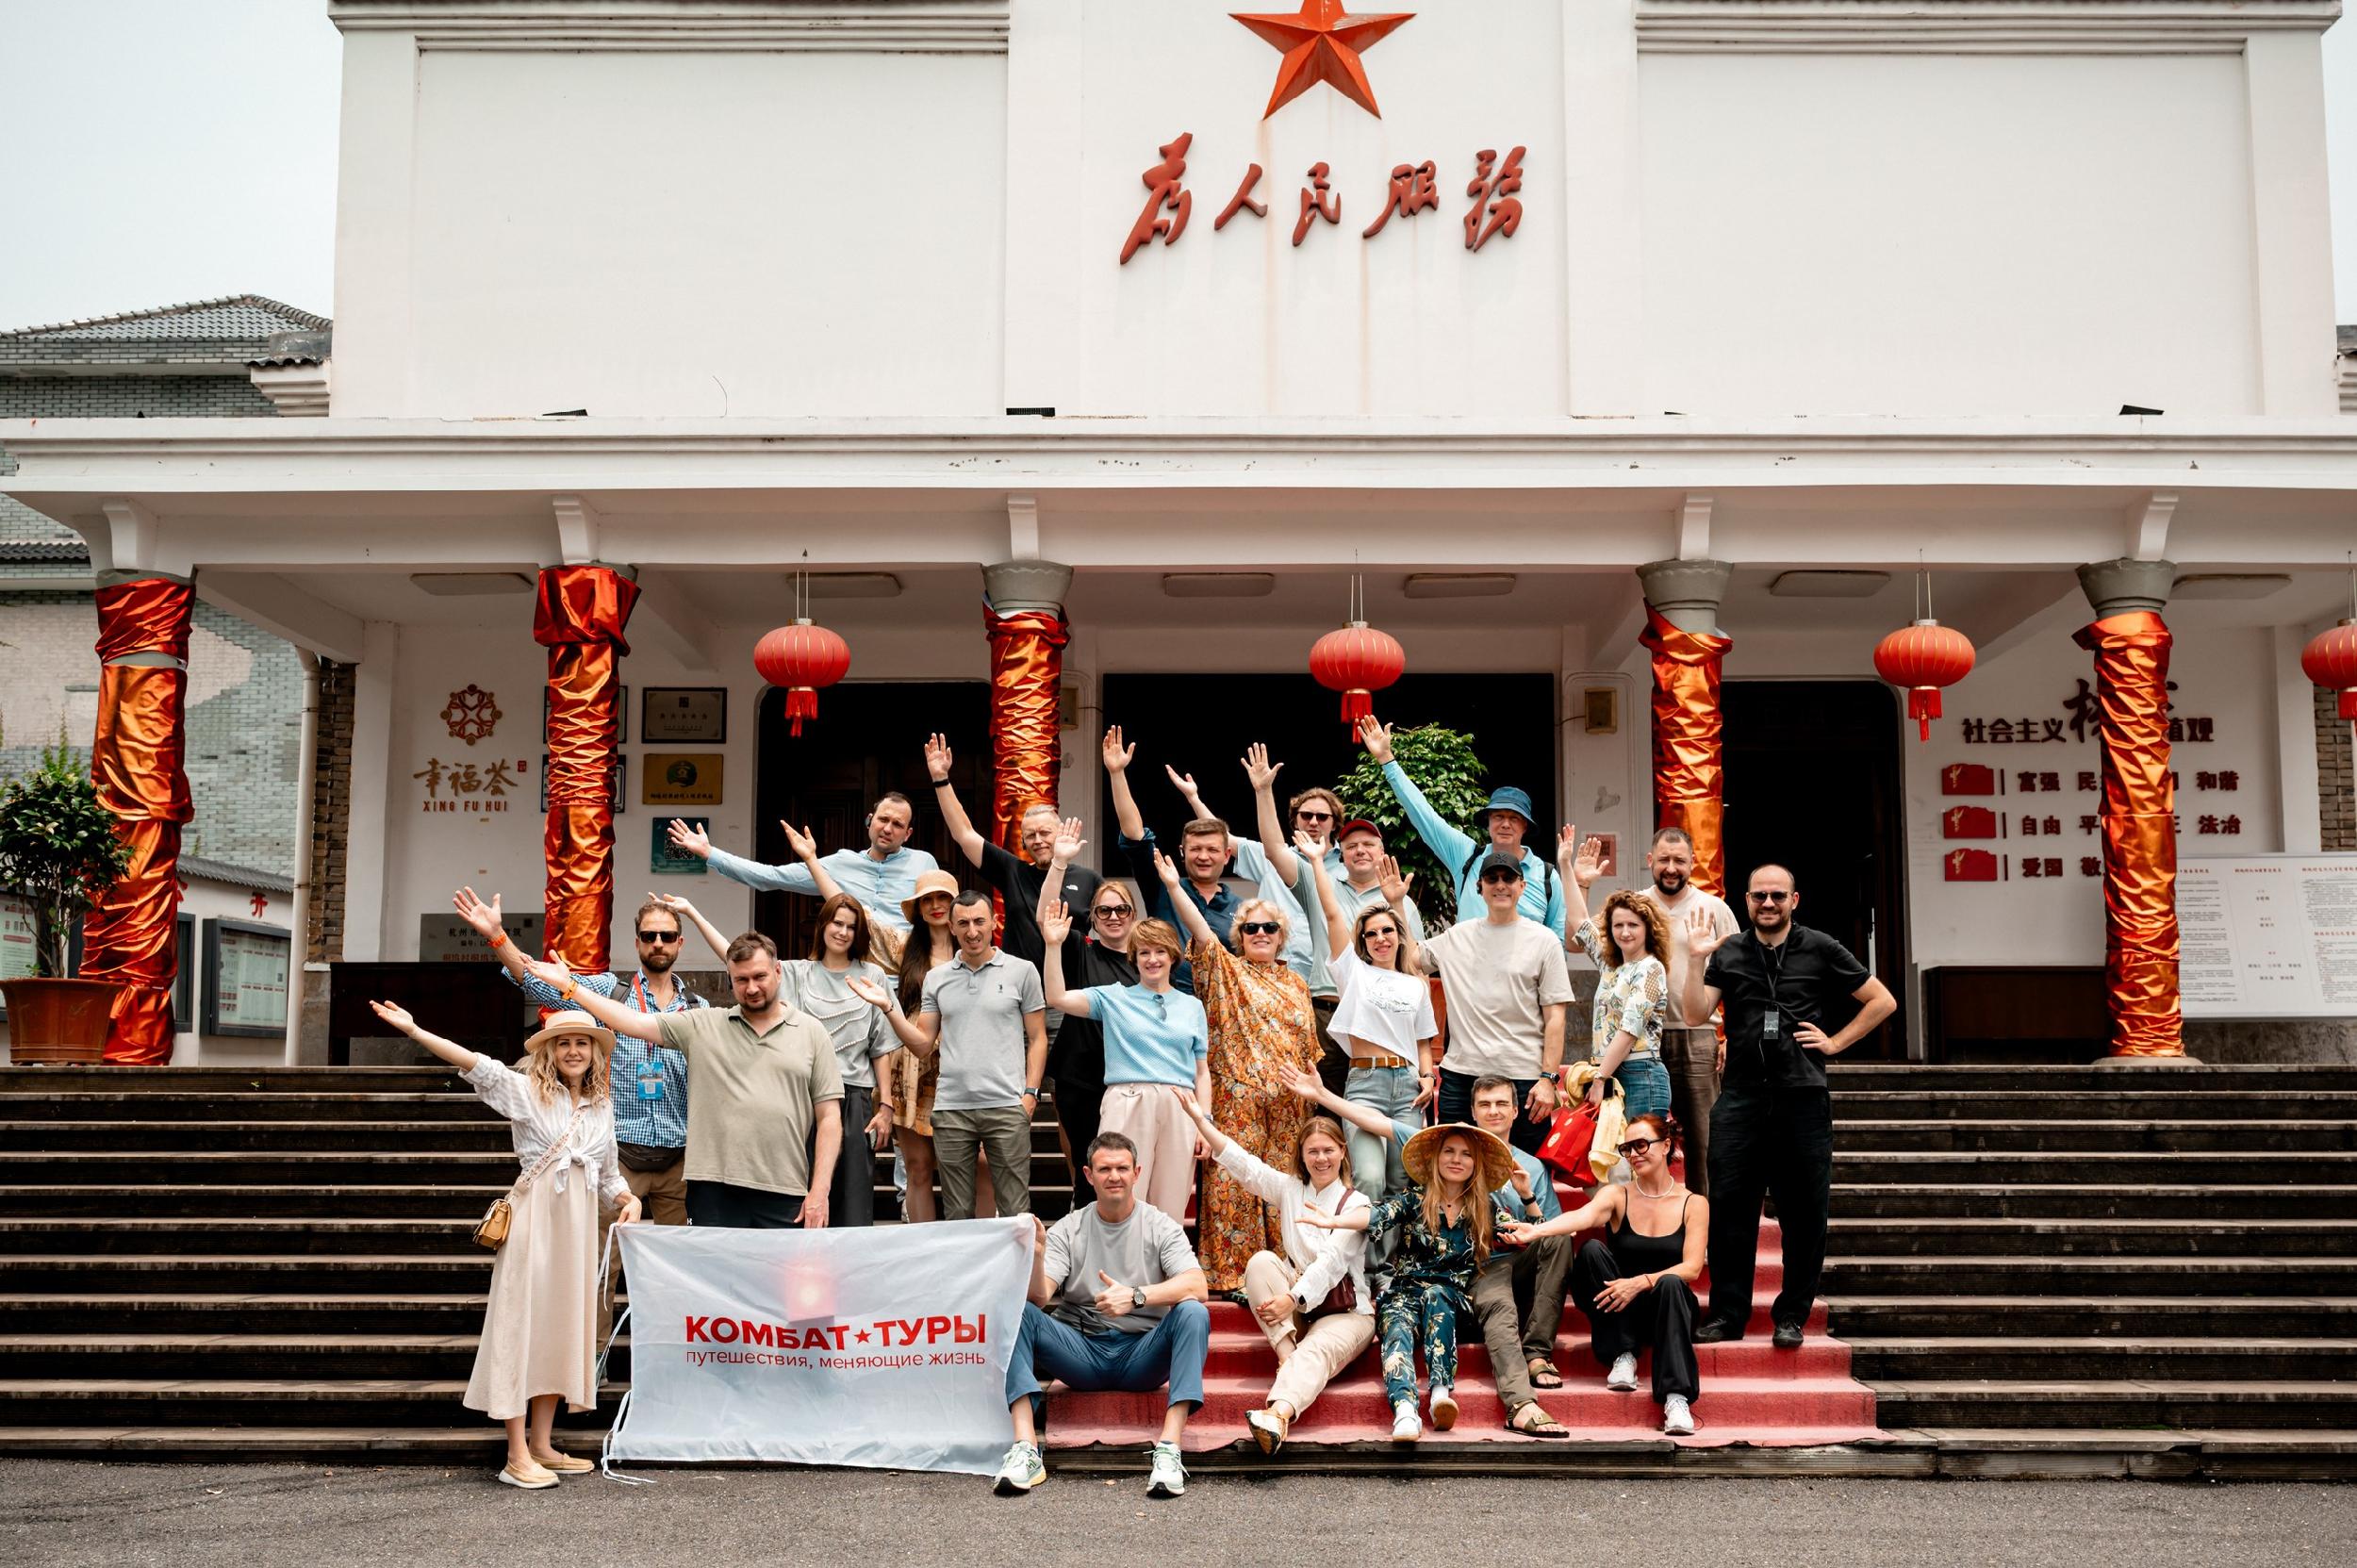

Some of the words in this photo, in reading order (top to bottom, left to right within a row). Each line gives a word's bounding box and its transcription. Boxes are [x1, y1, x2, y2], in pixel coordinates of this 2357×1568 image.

[2077, 771, 2102, 792] 民
[422, 801, 455, 812] XING
[464, 801, 479, 812] FU
[486, 801, 507, 812] HUI
[2021, 816, 2061, 835] 自由
[2199, 814, 2241, 834] 法治
[2022, 857, 2064, 878] 爱国
[2080, 857, 2105, 878] 敬
[684, 1315, 850, 1351] КОМБАТ
[873, 1313, 987, 1348] ТУРЫ
[685, 1349, 814, 1370] путешествия,
[819, 1352, 924, 1370] меняющие
[928, 1351, 986, 1365] жизнь
